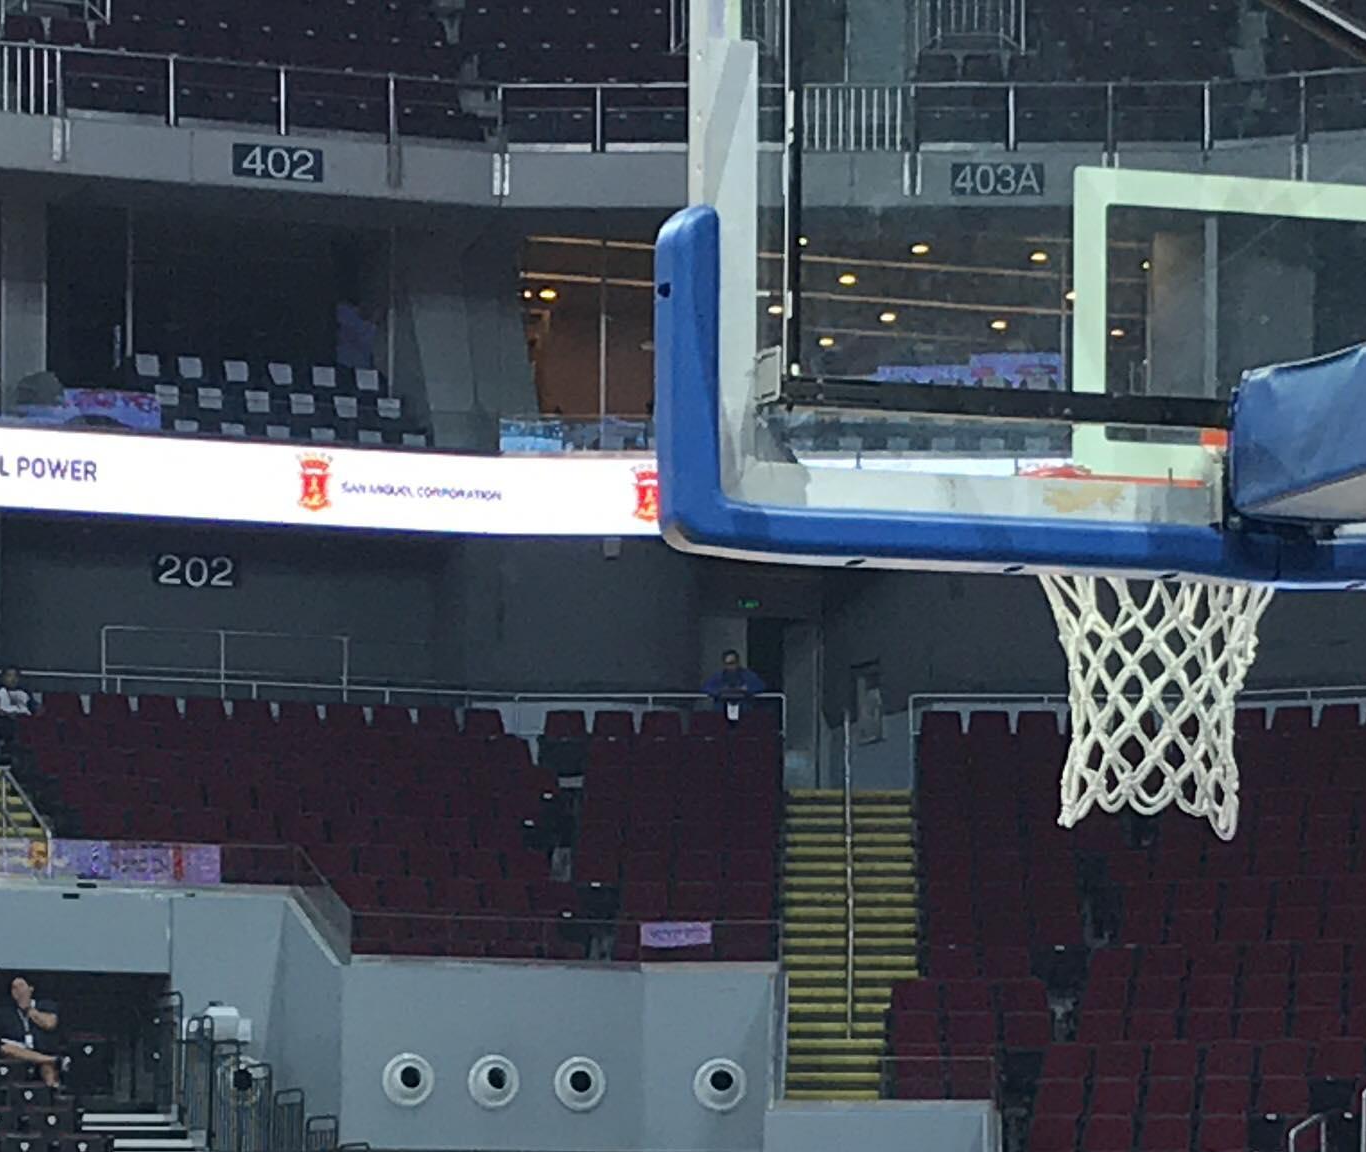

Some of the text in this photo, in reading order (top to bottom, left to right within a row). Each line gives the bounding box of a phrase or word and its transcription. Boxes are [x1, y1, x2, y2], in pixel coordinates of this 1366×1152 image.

[242, 146, 315, 180] 402
[955, 164, 1040, 194] 403A
[16, 456, 97, 482] POWER
[158, 555, 233, 587] 202
